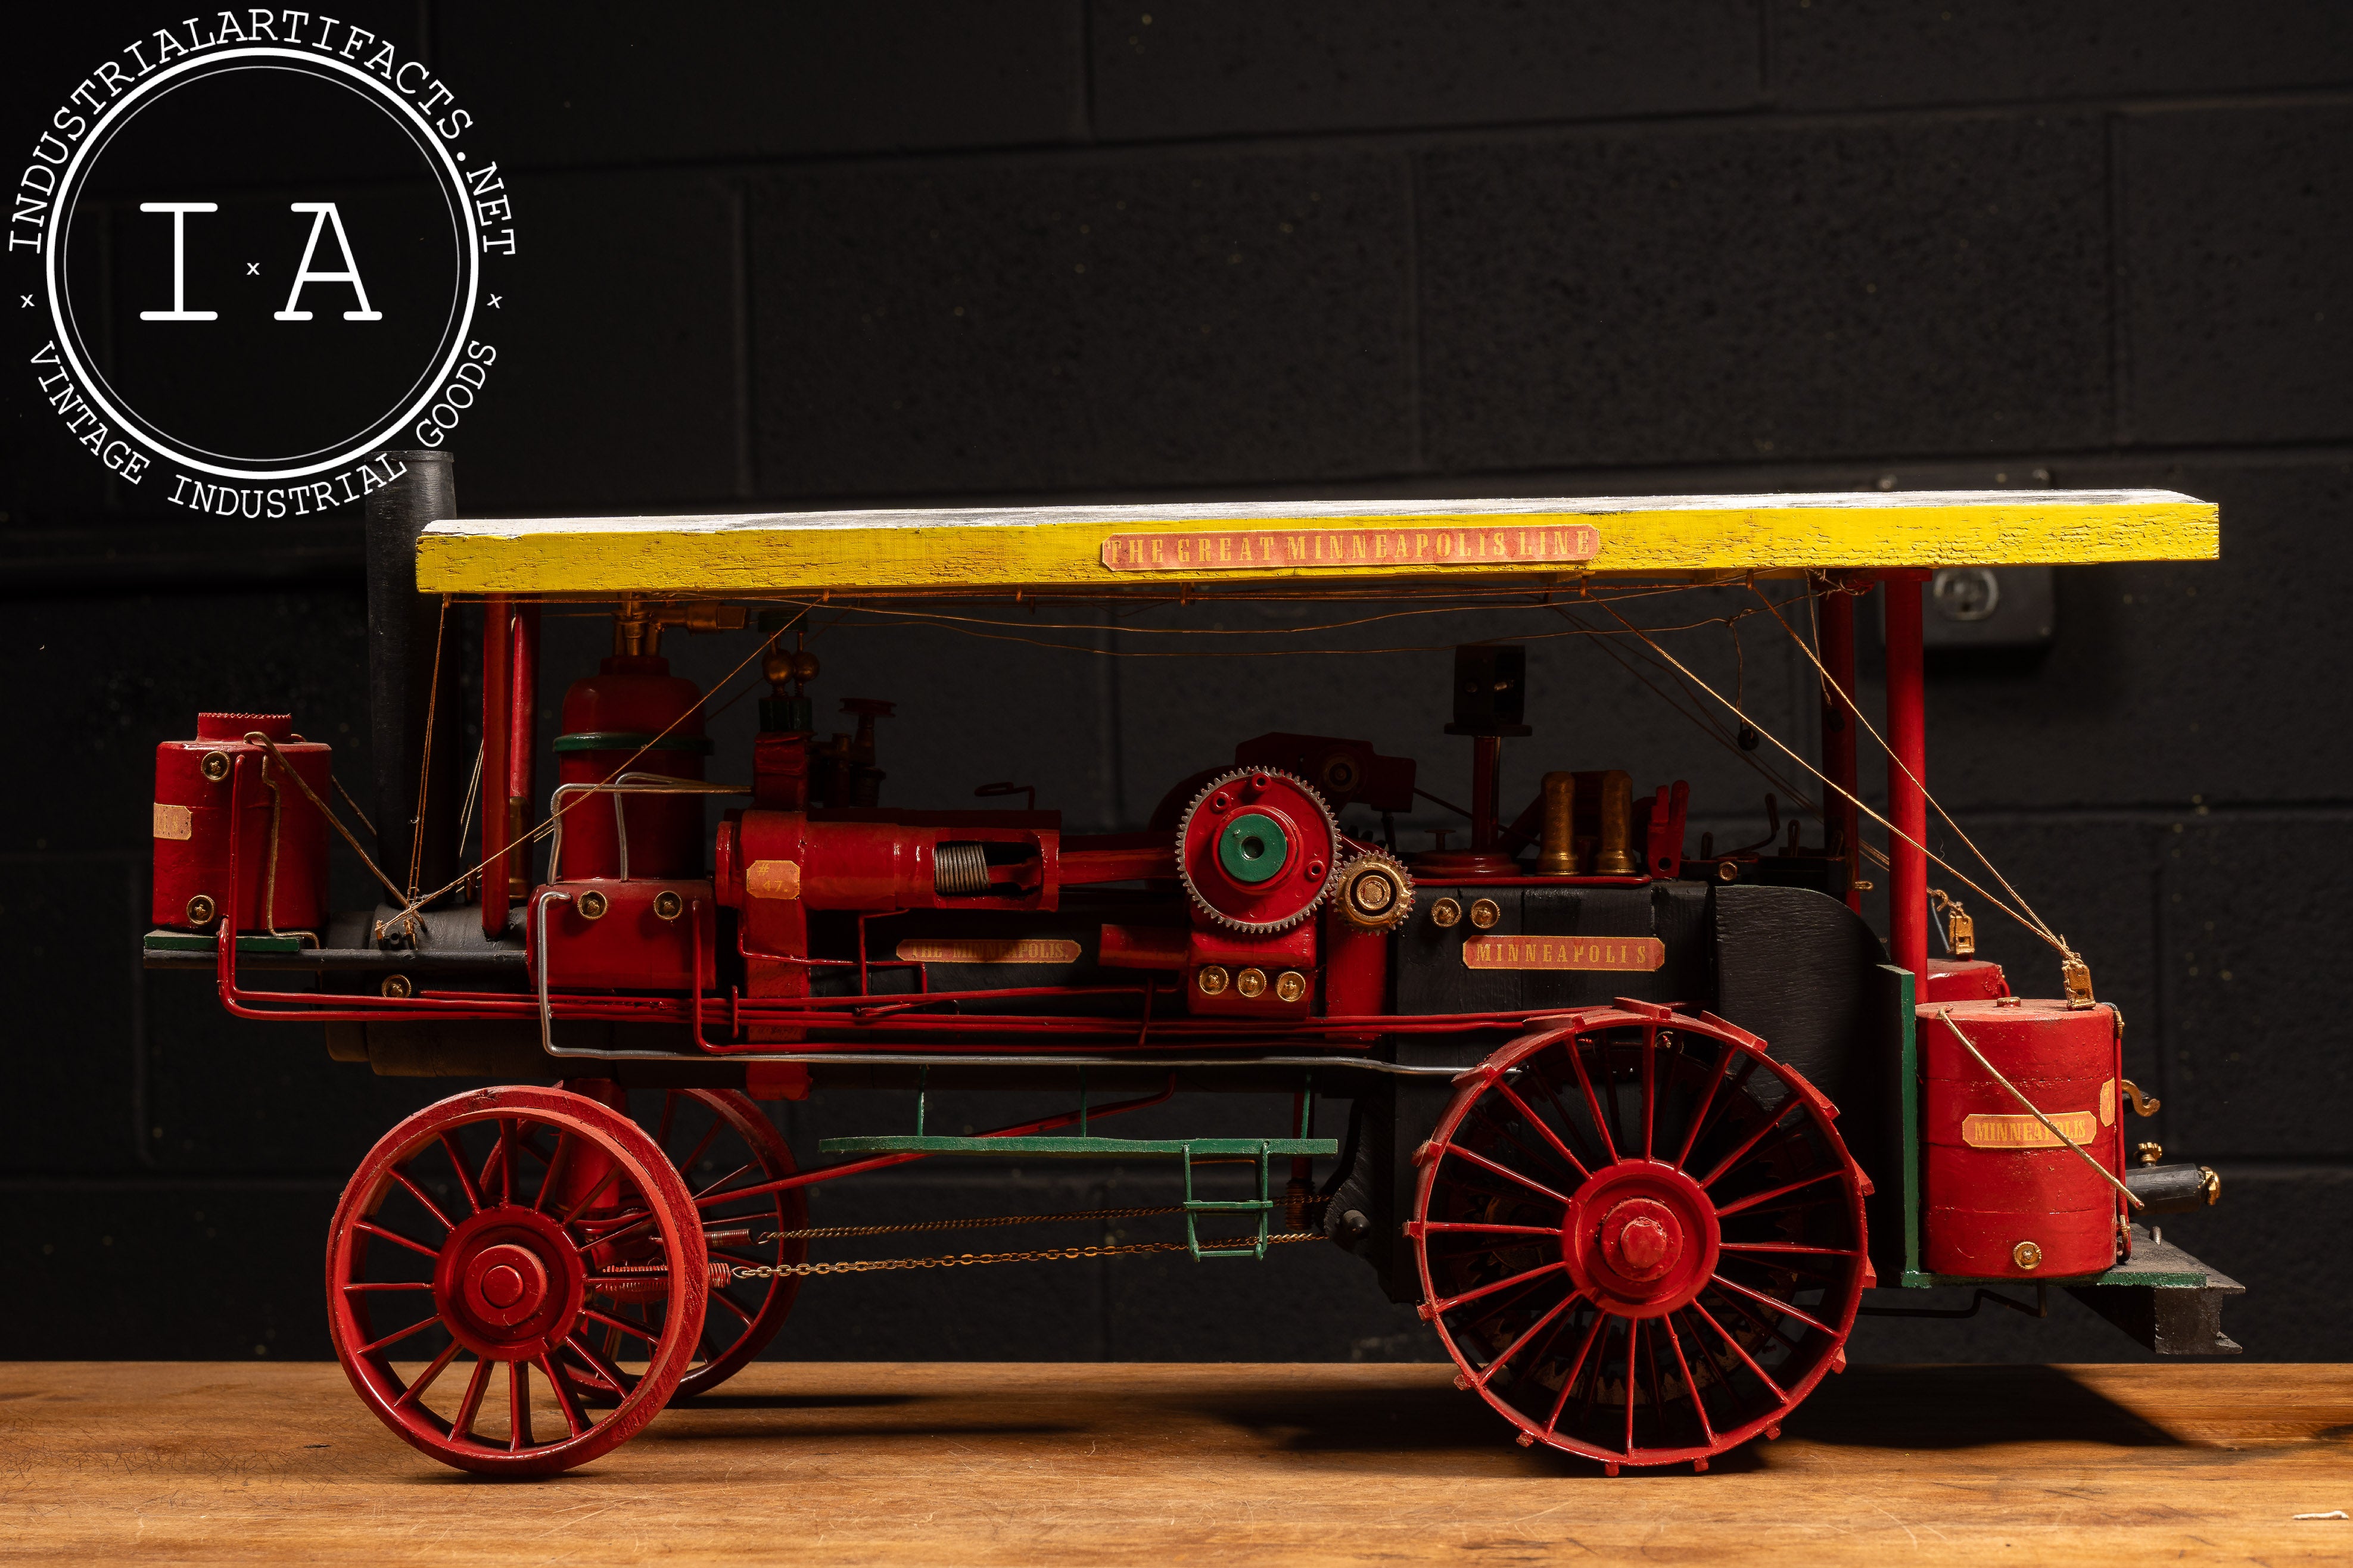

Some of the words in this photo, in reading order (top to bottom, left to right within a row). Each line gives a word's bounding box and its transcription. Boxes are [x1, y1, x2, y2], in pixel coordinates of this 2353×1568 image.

[1107, 539, 1164, 564] THE
[1177, 537, 1274, 563] GREAT
[1287, 532, 1506, 560] MINNEAPOLIS
[1519, 530, 1590, 556] LINE
[911, 943, 943, 958] THE
[1476, 943, 1647, 964] MINNEAPOLIS
